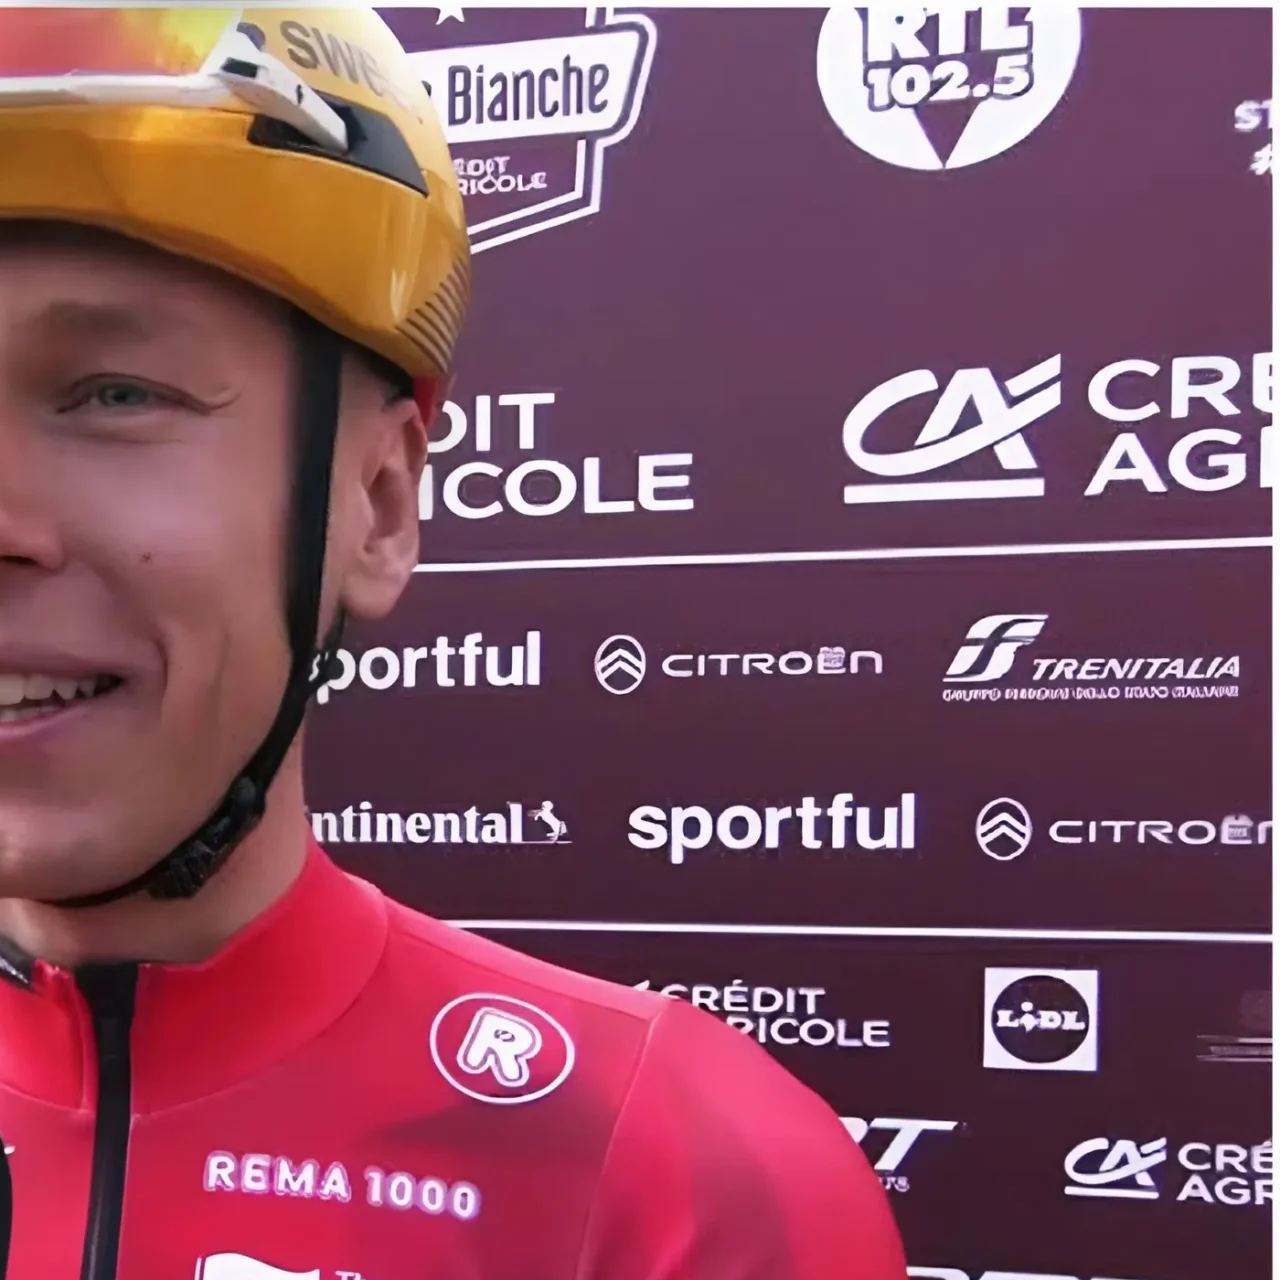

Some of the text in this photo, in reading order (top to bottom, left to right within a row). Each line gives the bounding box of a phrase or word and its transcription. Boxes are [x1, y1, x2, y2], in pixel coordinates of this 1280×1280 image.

[447, 54, 610, 127] Bianche
[865, 52, 1036, 110] 102.5
[1032, 656, 1240, 681] TRENITALIA
[310, 800, 524, 846] ntinental
[627, 792, 916, 864] sportful
[205, 1150, 482, 1220] REMA 1000
